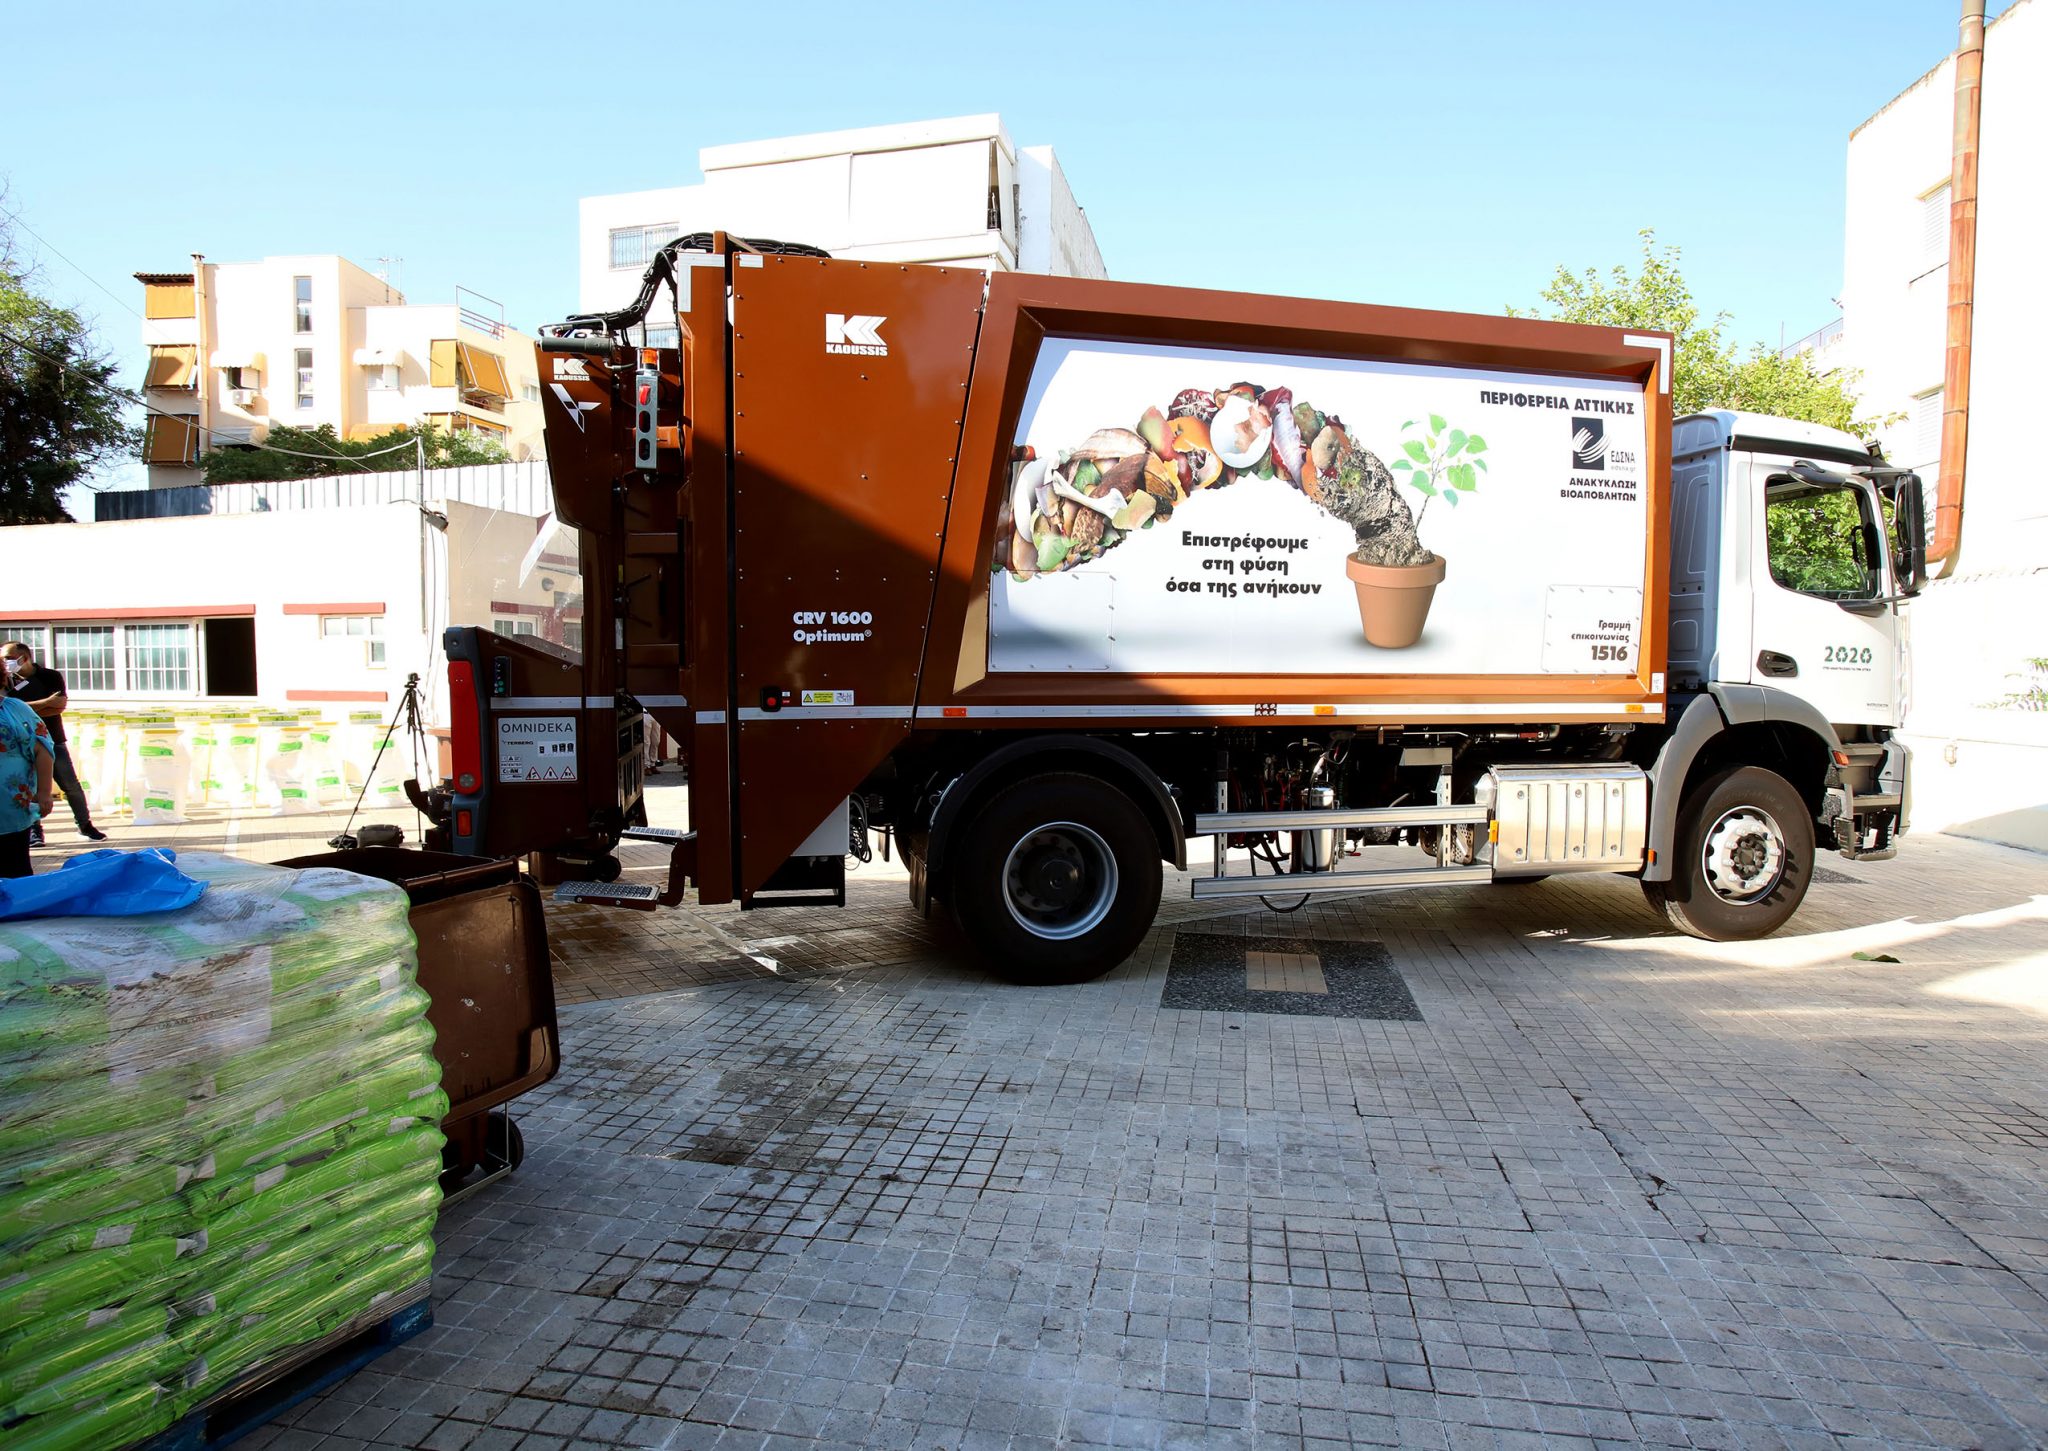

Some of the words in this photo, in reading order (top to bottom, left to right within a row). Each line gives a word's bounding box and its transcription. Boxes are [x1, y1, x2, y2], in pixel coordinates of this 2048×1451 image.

[825, 343, 889, 357] KAOUSSIS
[1480, 390, 1570, 411] ΠΕΡΙΦΕΡΕΙΑ
[1574, 398, 1635, 415] ΑΤΤΙΚΗΣ
[1610, 450, 1636, 463] ΕΔΣΝΑ
[1569, 477, 1637, 489] ΑΝΑΚΥΚΛΩΣΗ
[1560, 489, 1637, 502] ΒΙΟΑΠΟΒΛΗΤΩΝ
[1182, 530, 1309, 553] Επιστρέφουμε
[1202, 558, 1234, 575] στη
[1240, 556, 1289, 576] φύση
[1165, 577, 1201, 593] όσα
[1207, 581, 1238, 598] της
[1243, 578, 1323, 598] ανήκουν
[793, 611, 826, 625] CRV
[831, 611, 873, 625] 1600
[1598, 619, 1631, 632] Γραμμή
[1571, 632, 1630, 644] επικοινωνίας
[1591, 645, 1629, 662] 1516
[1824, 645, 1873, 664] 2020
[501, 722, 574, 734] OMNIDEKA
